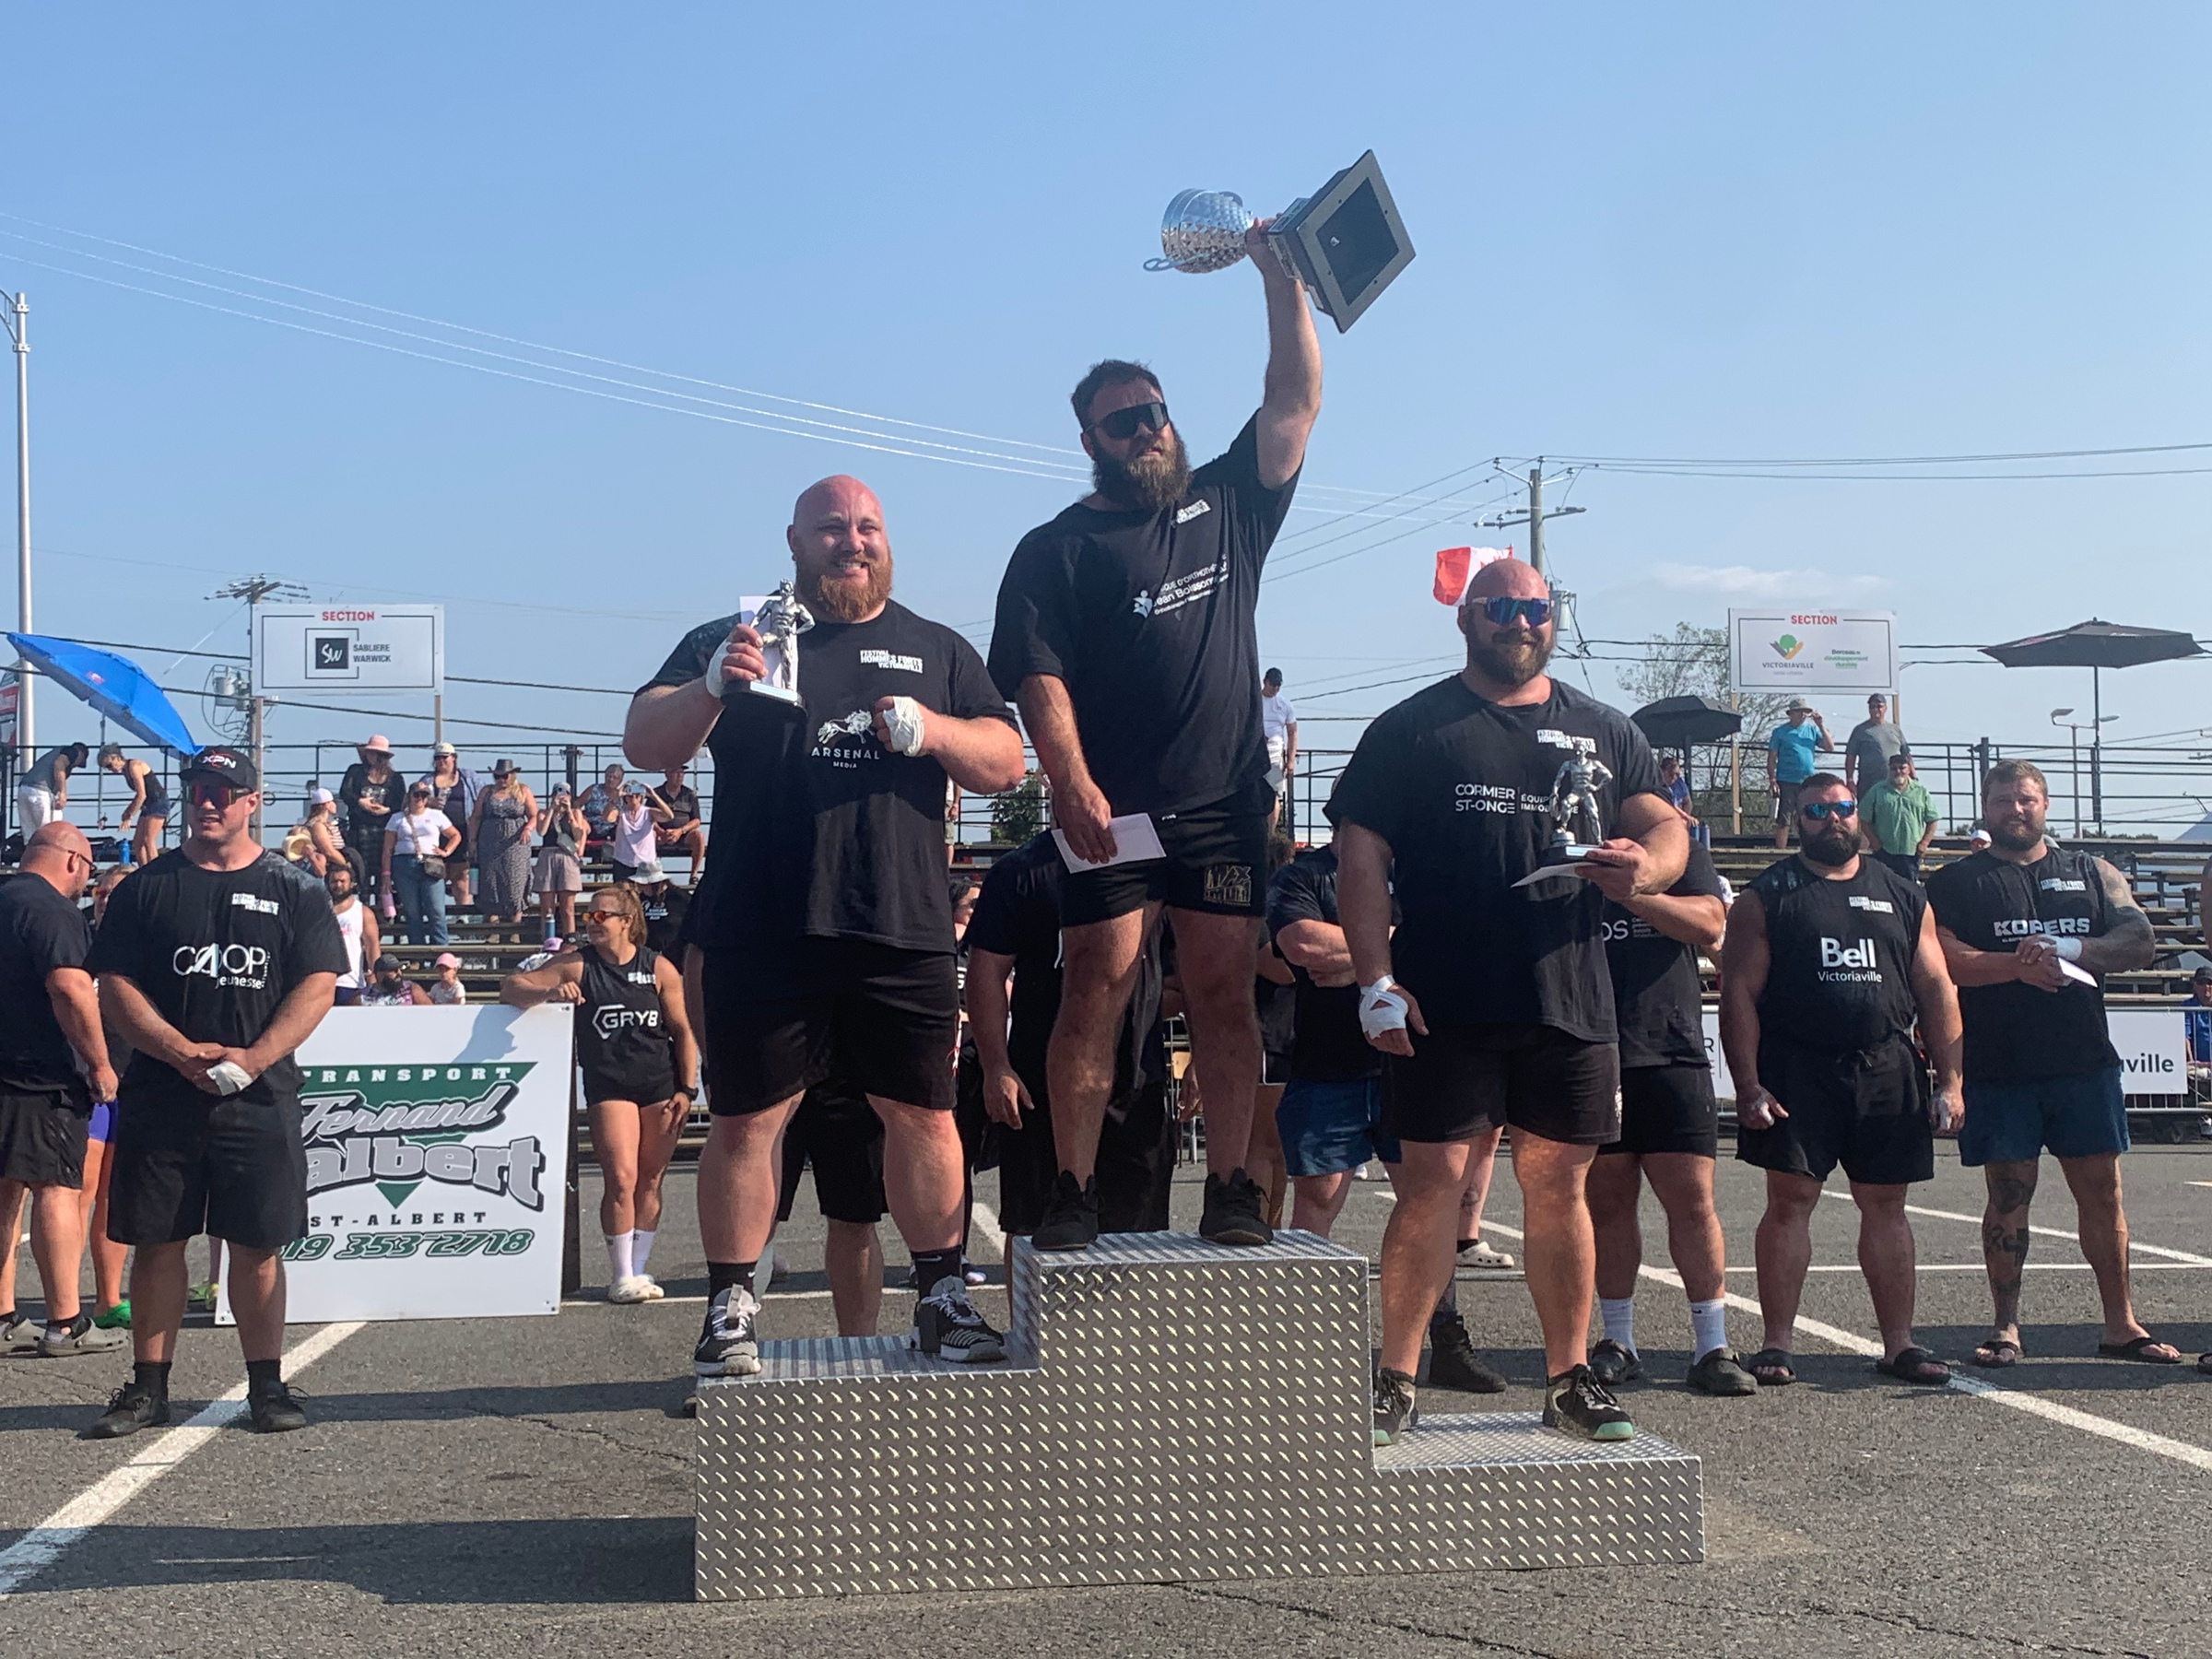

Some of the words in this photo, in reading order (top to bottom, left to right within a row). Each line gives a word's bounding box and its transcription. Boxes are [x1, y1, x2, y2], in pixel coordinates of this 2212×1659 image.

[322, 611, 375, 621] SECTION
[1791, 615, 1838, 625] SECTION
[860, 653, 897, 664] HOMMES
[811, 747, 879, 760] ARSENAL
[1455, 784, 1516, 800] CORMIER
[1521, 794, 1549, 804] ÉQUIP
[1455, 799, 1516, 814] ST-ONGE
[1821, 937, 1877, 969] Bell
[215, 976, 262, 989] jeunesse
[1818, 971, 1883, 983] Victoriaville
[601, 1010, 659, 1030] GRYB
[300, 1084, 512, 1137] Fernand
[306, 1135, 542, 1207] albert
[310, 1211, 487, 1228] ST-ALBERT
[279, 1234, 334, 1261] 19
[334, 1230, 535, 1260] 353-2718
